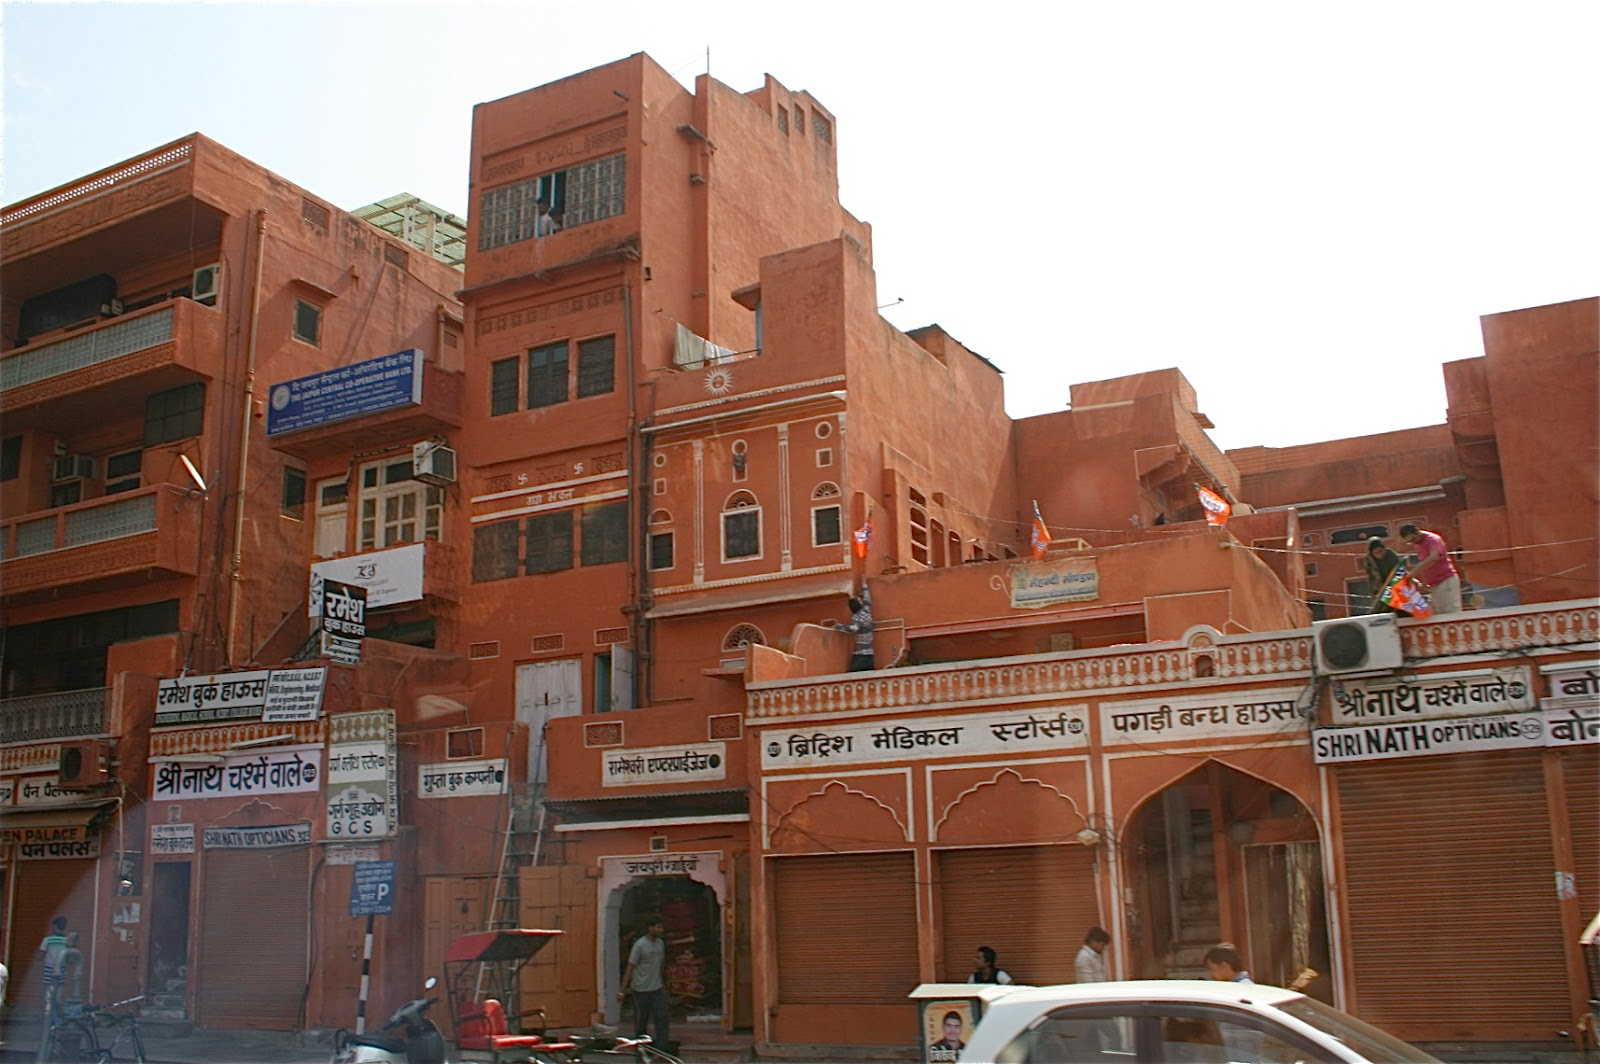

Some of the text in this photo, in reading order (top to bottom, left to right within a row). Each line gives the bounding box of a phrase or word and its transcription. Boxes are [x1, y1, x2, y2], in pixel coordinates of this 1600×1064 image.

[326, 587, 365, 623] रमेश
[325, 617, 341, 632] बुक
[159, 680, 191, 705] रमेश
[193, 683, 220, 708] बुक
[1366, 684, 1421, 717] नाथ
[1424, 680, 1467, 707] चश्में
[1470, 676, 1507, 703] वाले
[871, 726, 964, 749] मेडिकल
[989, 712, 1068, 741] स्टोर्स
[1112, 705, 1172, 734] पगड़ी
[1234, 700, 1296, 726] हाउस
[1317, 734, 1363, 758] SHRI
[1365, 725, 1430, 754] NATH
[1432, 721, 1521, 743] OPTICIANS
[157, 761, 181, 794] श्री
[183, 765, 225, 794] नाथ
[229, 756, 269, 791] चश्में
[271, 754, 303, 788] वाले
[423, 766, 494, 792] गुप्ता बुक कम्पनी
[0, 828, 77, 842] EN PALACE
[205, 832, 221, 846] SHRI
[222, 832, 242, 846] NATH
[244, 829, 295, 845] OPTICIANS
[378, 883, 389, 901] P
